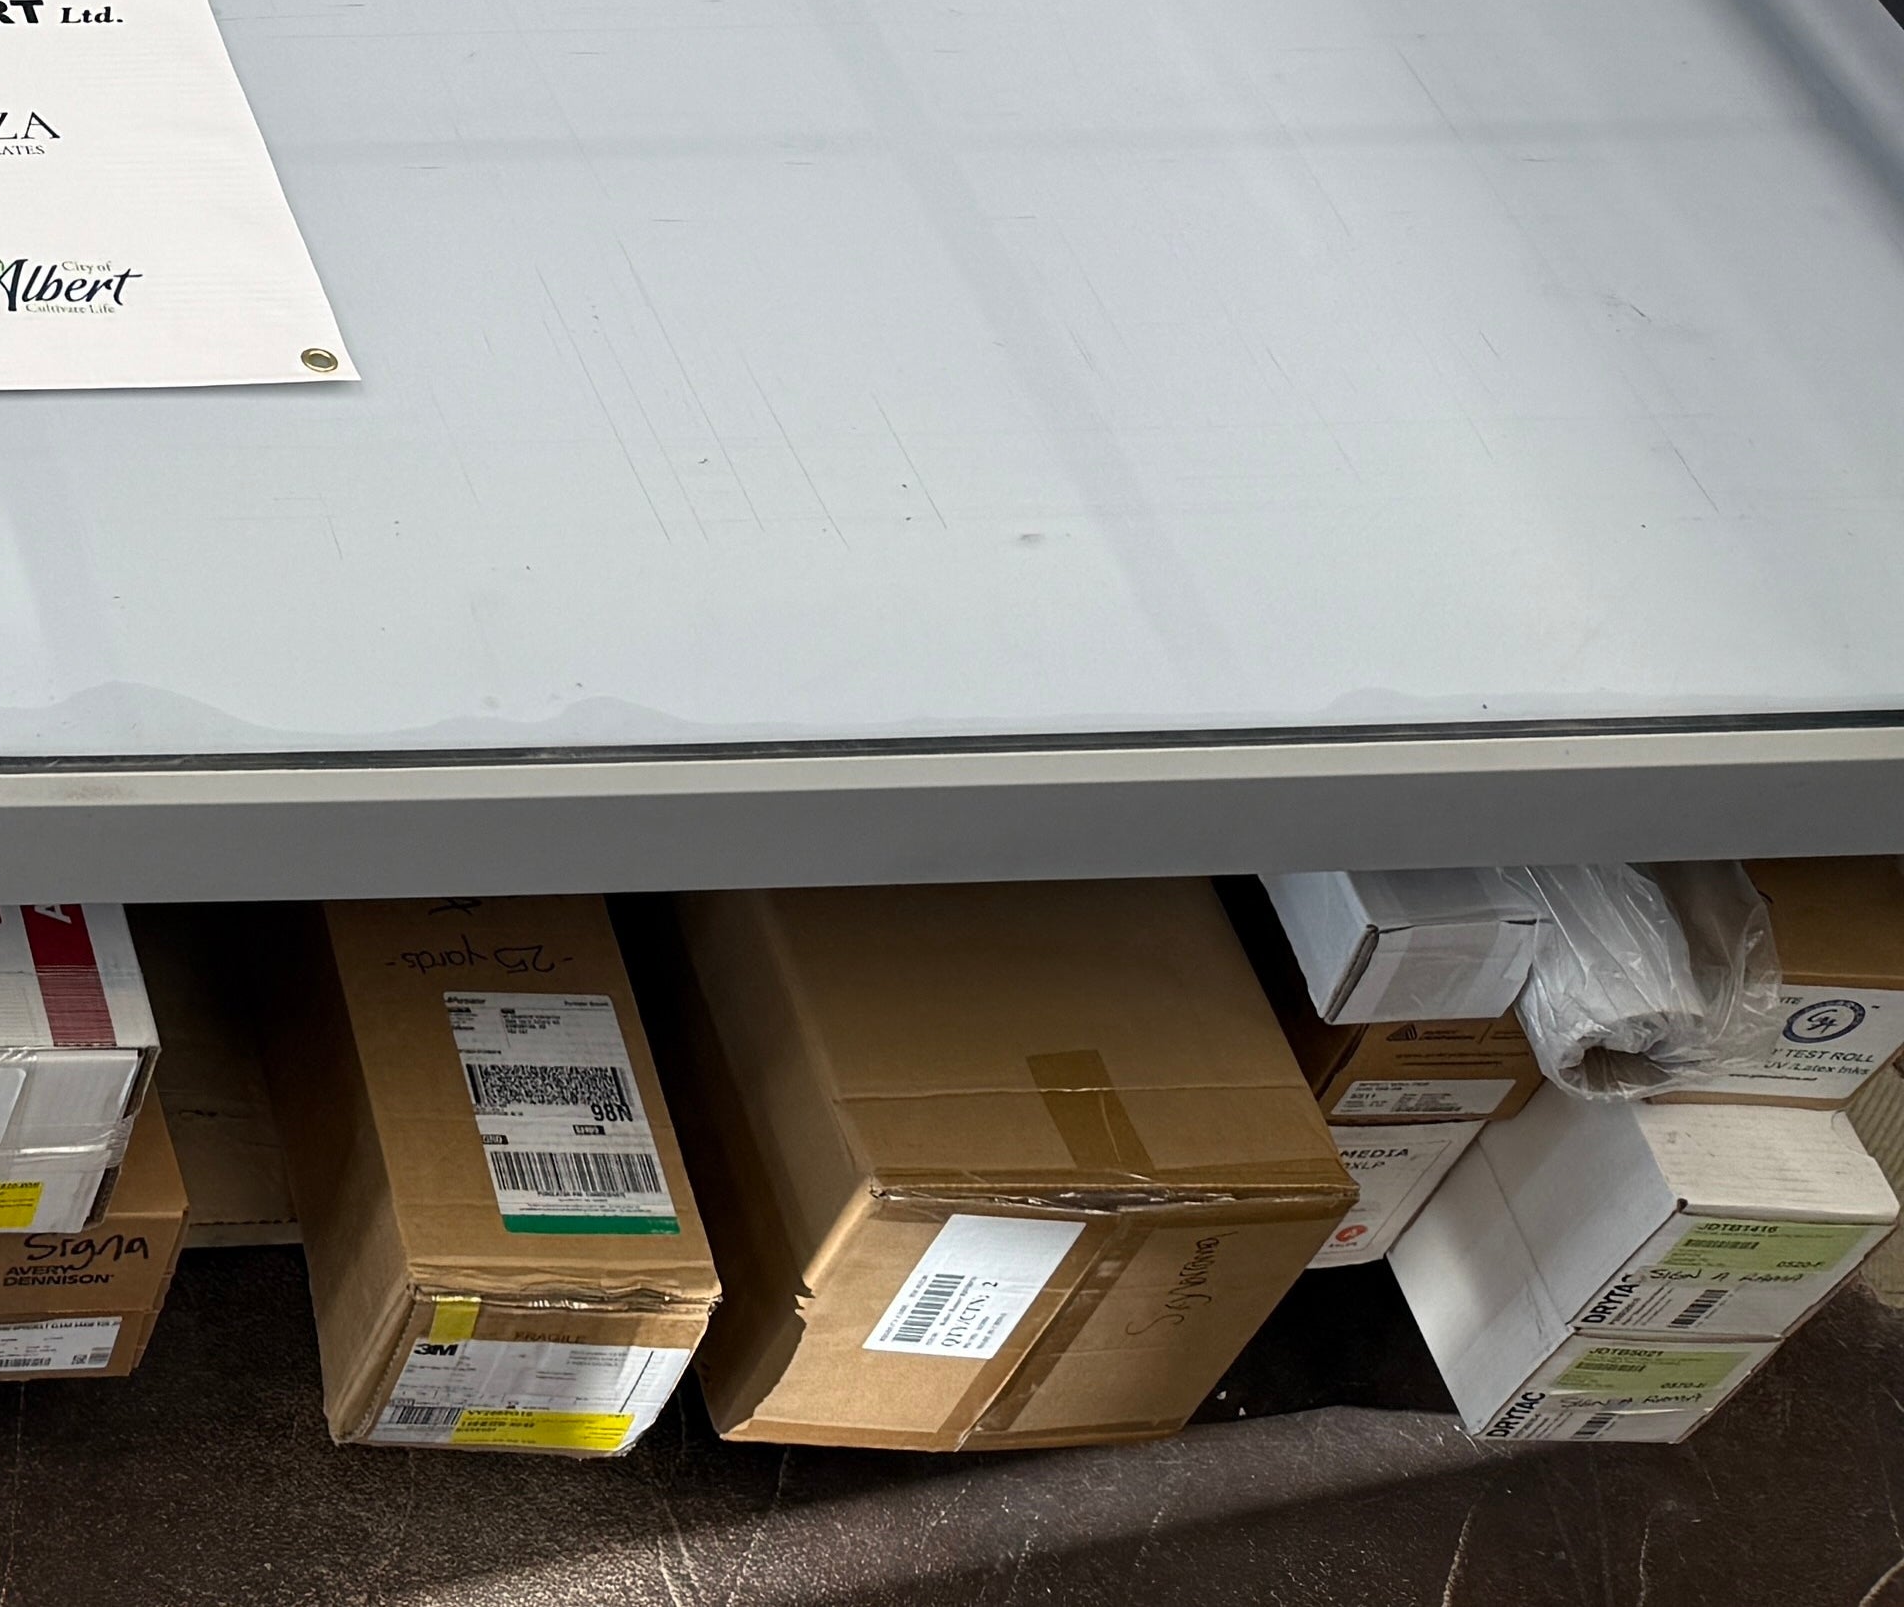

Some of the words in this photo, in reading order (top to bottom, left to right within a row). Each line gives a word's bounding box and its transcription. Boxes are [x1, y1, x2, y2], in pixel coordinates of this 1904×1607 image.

[60, 6, 124, 25] Ltd.
[61, 260, 93, 274] City
[97, 260, 112, 272] of
[400, 935, 489, 971] yards
[494, 945, 556, 974] 25
[1785, 1049, 1830, 1059] TEST
[1829, 1051, 1876, 1063] ROLL
[591, 1104, 634, 1122] 98N
[1340, 1148, 1409, 1159] MEDIA
[5, 1265, 69, 1277] AVERY
[3, 1274, 111, 1287] DENNISON
[413, 1344, 458, 1356] 3M
[1486, 1391, 1546, 1438] DRYTAC
